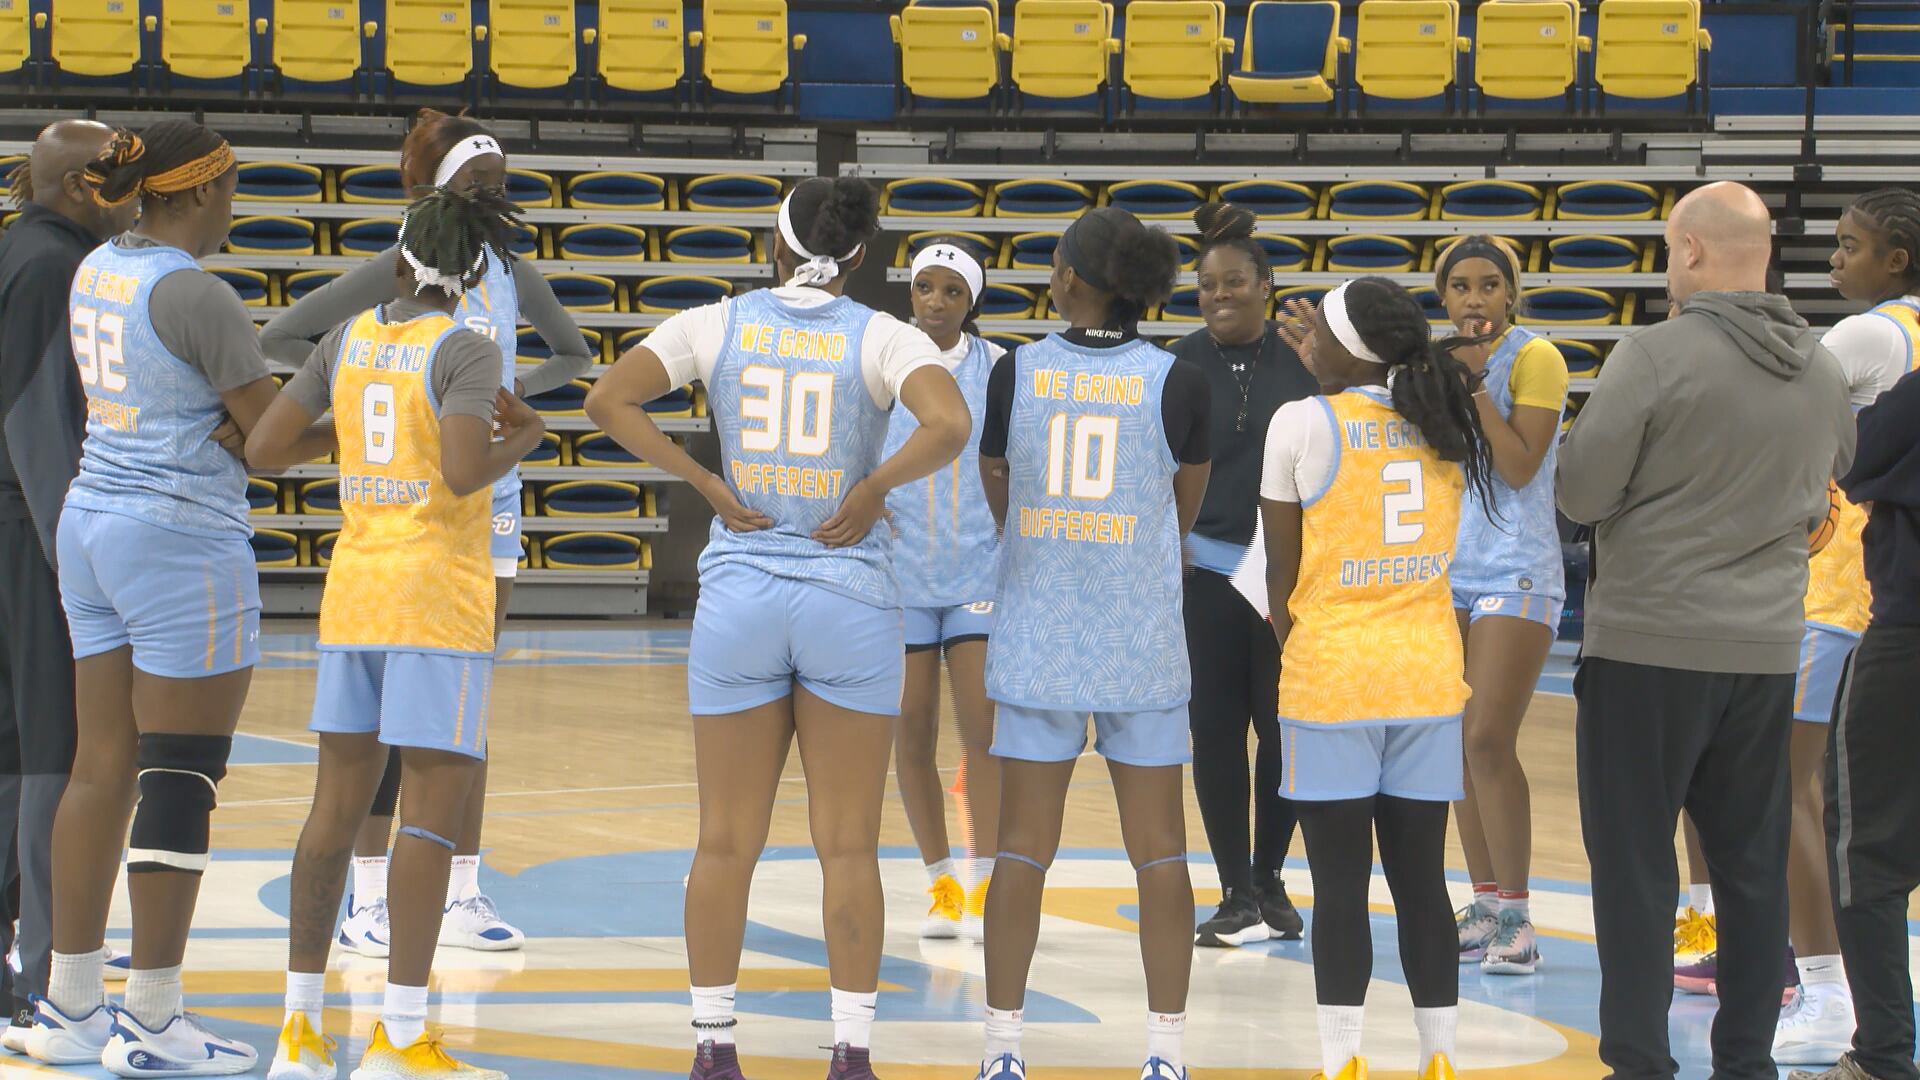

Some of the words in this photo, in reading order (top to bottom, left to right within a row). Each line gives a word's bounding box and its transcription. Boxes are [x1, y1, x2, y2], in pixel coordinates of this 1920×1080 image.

[76, 267, 97, 295] WE
[73, 305, 127, 392] 32
[741, 323, 774, 354] WE
[778, 327, 846, 362] GRIND
[1085, 328, 1105, 338] NIKE
[1104, 330, 1123, 339] PRO
[346, 338, 372, 368] WE
[1034, 368, 1069, 399] WE
[1073, 371, 1144, 406] GRIND
[362, 382, 396, 465] 8
[741, 366, 834, 456] 30
[1344, 419, 1380, 449] WE
[1046, 412, 1119, 500] 10
[339, 475, 431, 505] IFFERENT
[731, 459, 844, 499] DIFFERENT
[1382, 460, 1424, 545] 2
[1020, 507, 1137, 545] DIFFERENT
